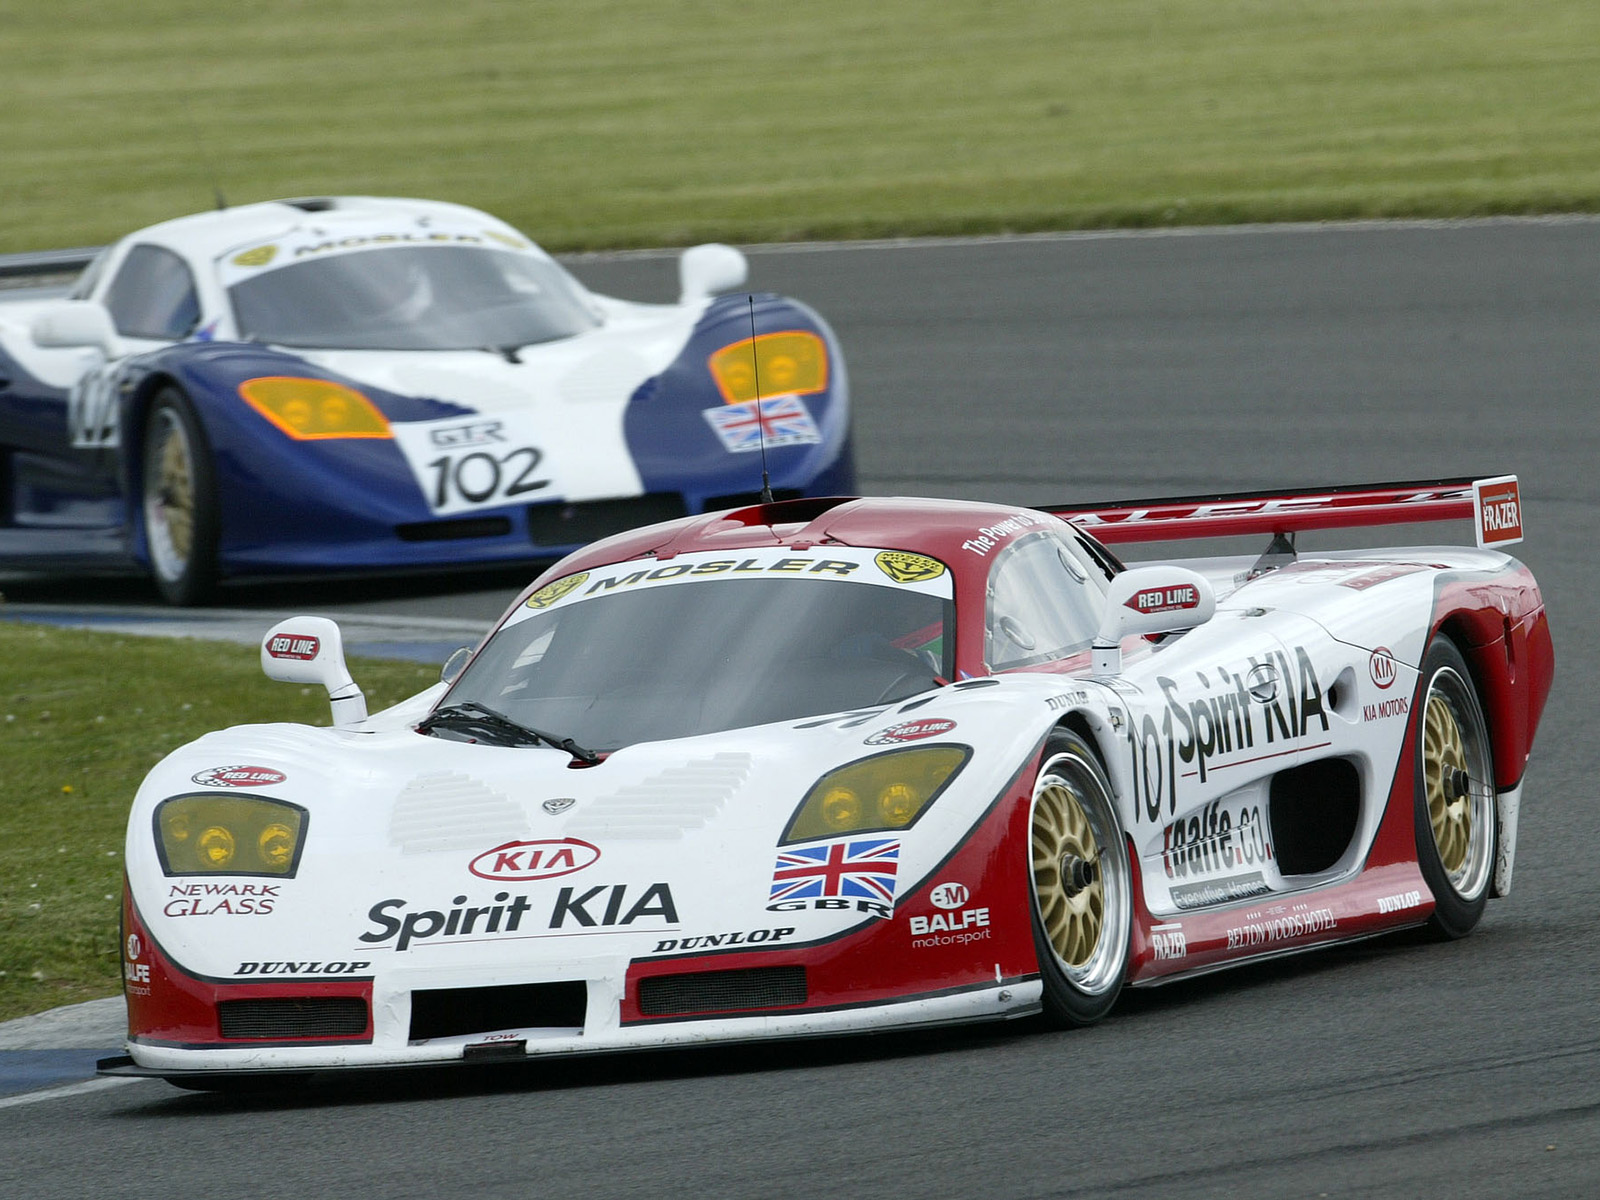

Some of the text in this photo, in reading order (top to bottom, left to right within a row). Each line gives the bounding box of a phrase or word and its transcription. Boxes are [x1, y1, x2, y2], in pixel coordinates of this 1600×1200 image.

[428, 447, 552, 507] 102
[1482, 501, 1520, 532] FRAZER
[978, 517, 1022, 541] Power
[961, 535, 996, 557] The
[583, 557, 860, 597] MOSLER
[1138, 591, 1164, 609] RED
[1166, 588, 1194, 605] LINE
[271, 637, 316, 655] RED LINE
[1373, 656, 1394, 680] KIA
[1156, 645, 1330, 784] Spirit KIA
[1363, 696, 1409, 723] KIA MOTORS
[893, 726, 920, 736] RED
[921, 722, 952, 732] LINE
[1127, 704, 1176, 824] 101
[222, 772, 250, 780] RED
[250, 772, 282, 782] LINE
[492, 848, 575, 873] KIA
[168, 883, 282, 898] NEWARK
[1172, 885, 1226, 909] Executive
[1377, 890, 1421, 915] DUNLOP
[163, 898, 276, 918] GLASS
[358, 882, 681, 952] Spirit KIA
[765, 899, 894, 917] GBR
[909, 907, 991, 936] BALFE
[1226, 907, 1338, 950] BELTON WOODS HOTEL
[651, 927, 796, 953] DUNLOP
[912, 928, 992, 949] motorsport
[1151, 931, 1187, 961] FRAZER
[233, 961, 372, 975] DUNLOP
[484, 1033, 519, 1041] TOW
